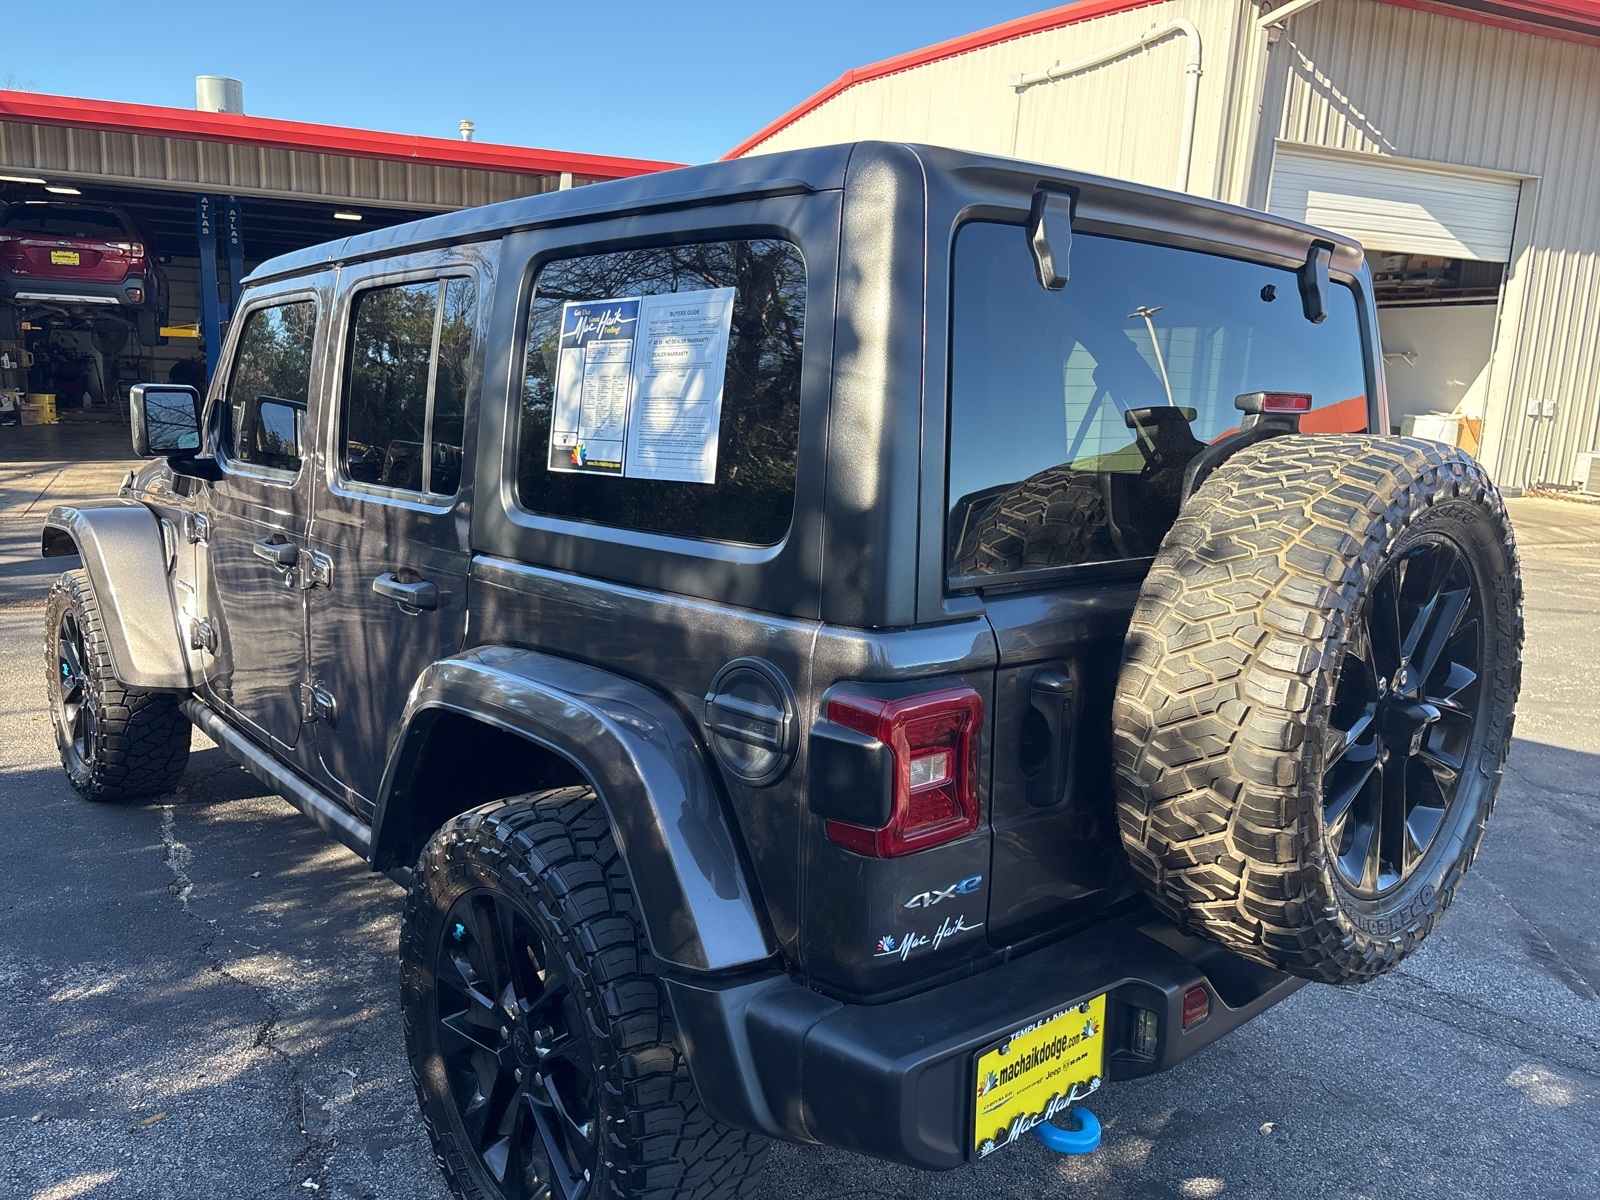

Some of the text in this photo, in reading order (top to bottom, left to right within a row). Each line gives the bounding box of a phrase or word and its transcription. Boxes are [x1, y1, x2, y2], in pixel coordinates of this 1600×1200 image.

[201, 197, 209, 234] ATLAS
[229, 209, 238, 244] ATLAS
[565, 316, 597, 344] Mac
[596, 307, 632, 340] Haik
[748, 722, 772, 735] FUEL
[883, 915, 979, 961] Mac Haik
[1010, 1019, 1043, 1042] TEMPLE
[999, 1033, 1081, 1087] machaikdodge.com
[983, 1090, 1013, 1110] CHRYSLER
[1045, 1067, 1061, 1080] Jeep
[1069, 1052, 1088, 1066] RAM
[1001, 1084, 1089, 1146] Mac Haik
